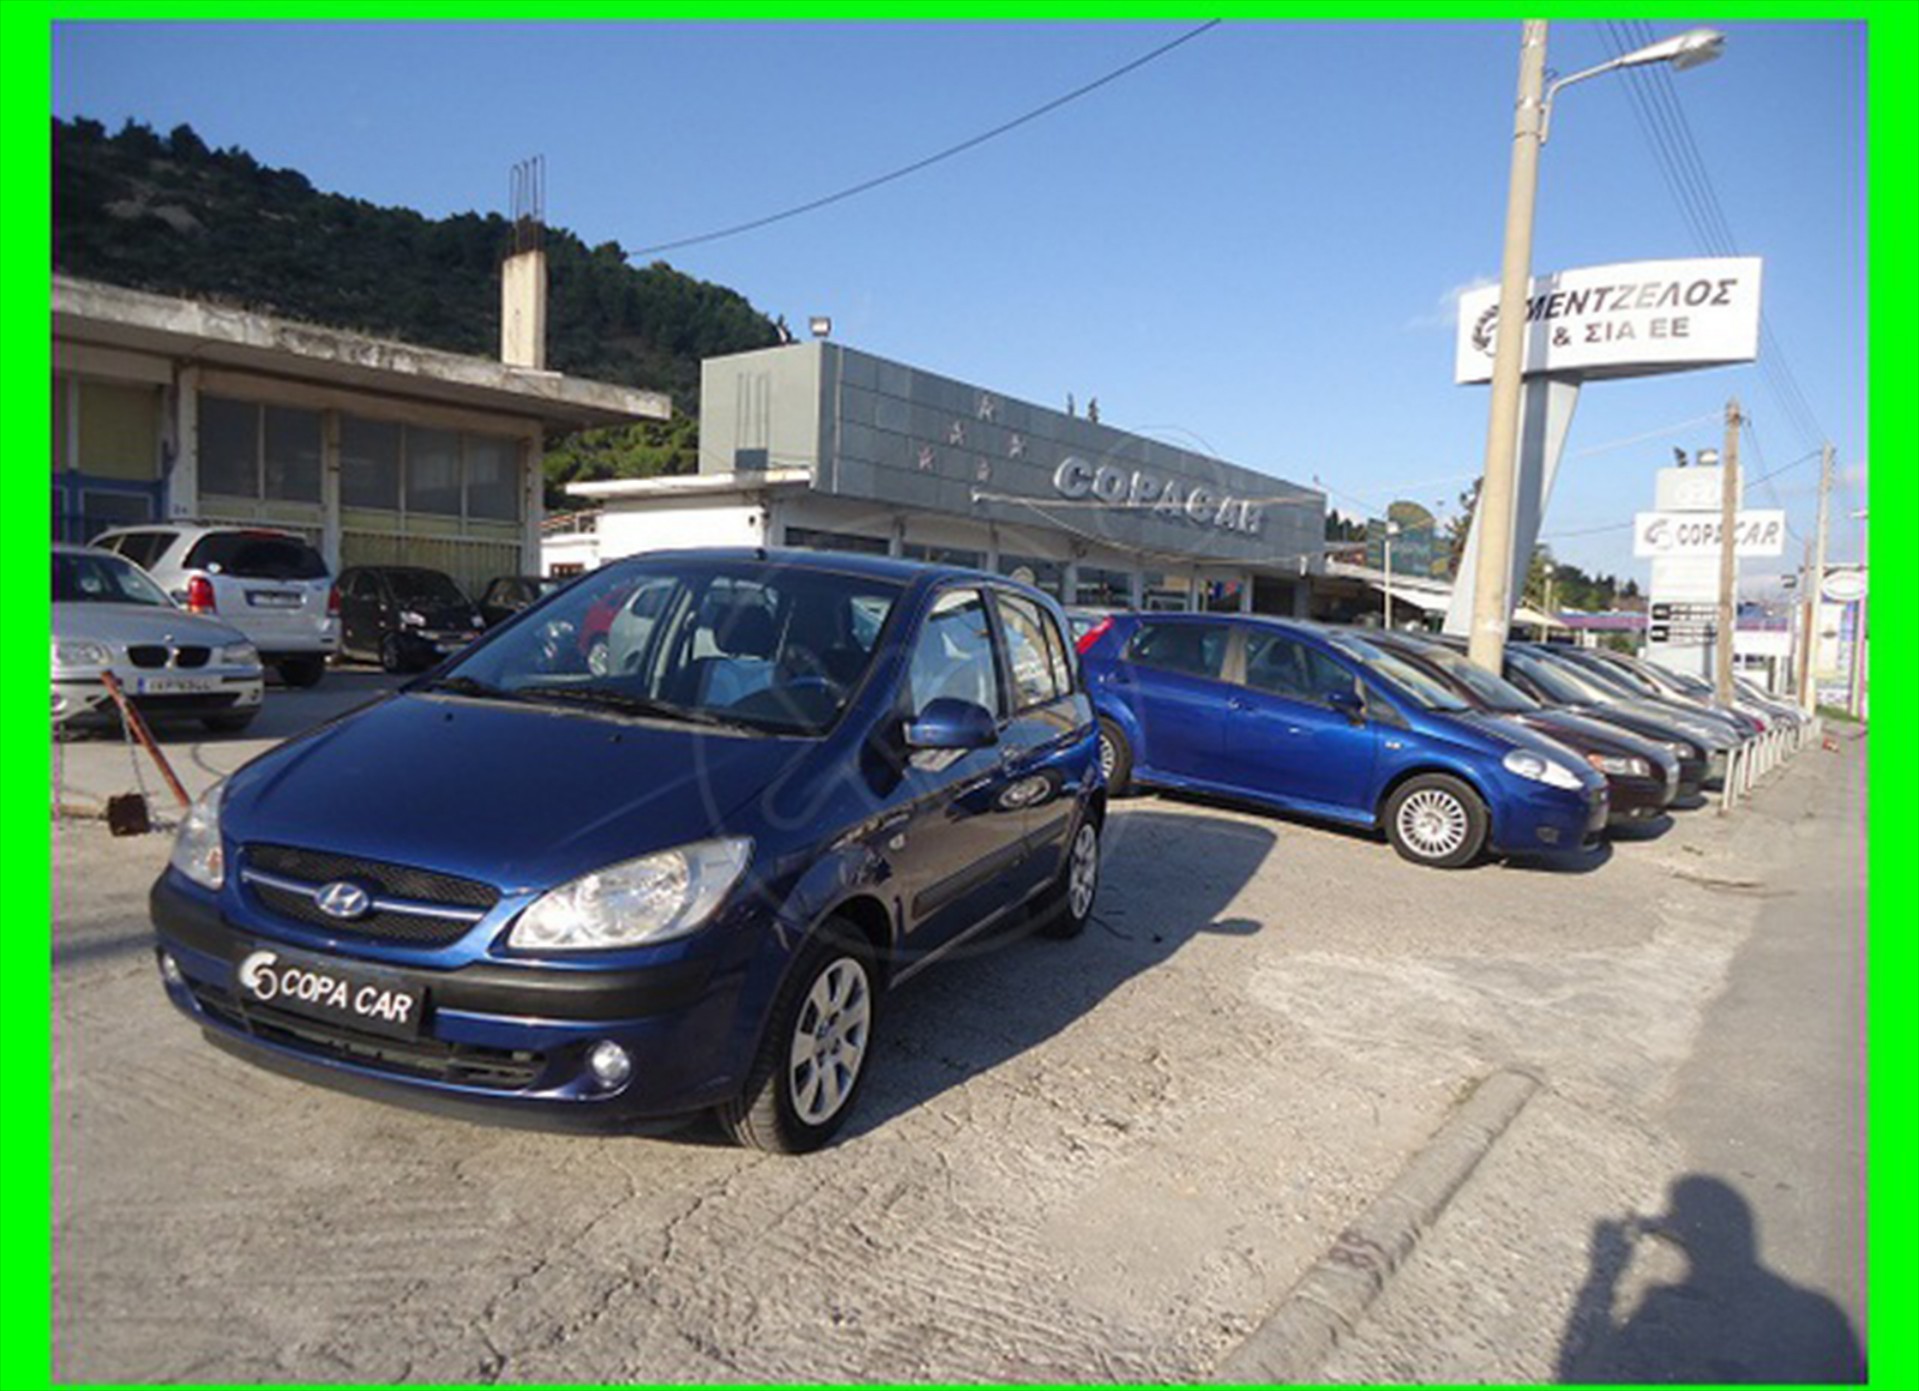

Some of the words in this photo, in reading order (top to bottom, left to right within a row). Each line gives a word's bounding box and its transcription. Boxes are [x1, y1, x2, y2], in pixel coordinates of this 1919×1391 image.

[1552, 326, 1572, 347] &
[1585, 319, 1636, 343] ΣΙΑ
[1649, 316, 1691, 338] ΕΕ
[281, 968, 347, 1009] COPA
[354, 986, 413, 1023] CAR
